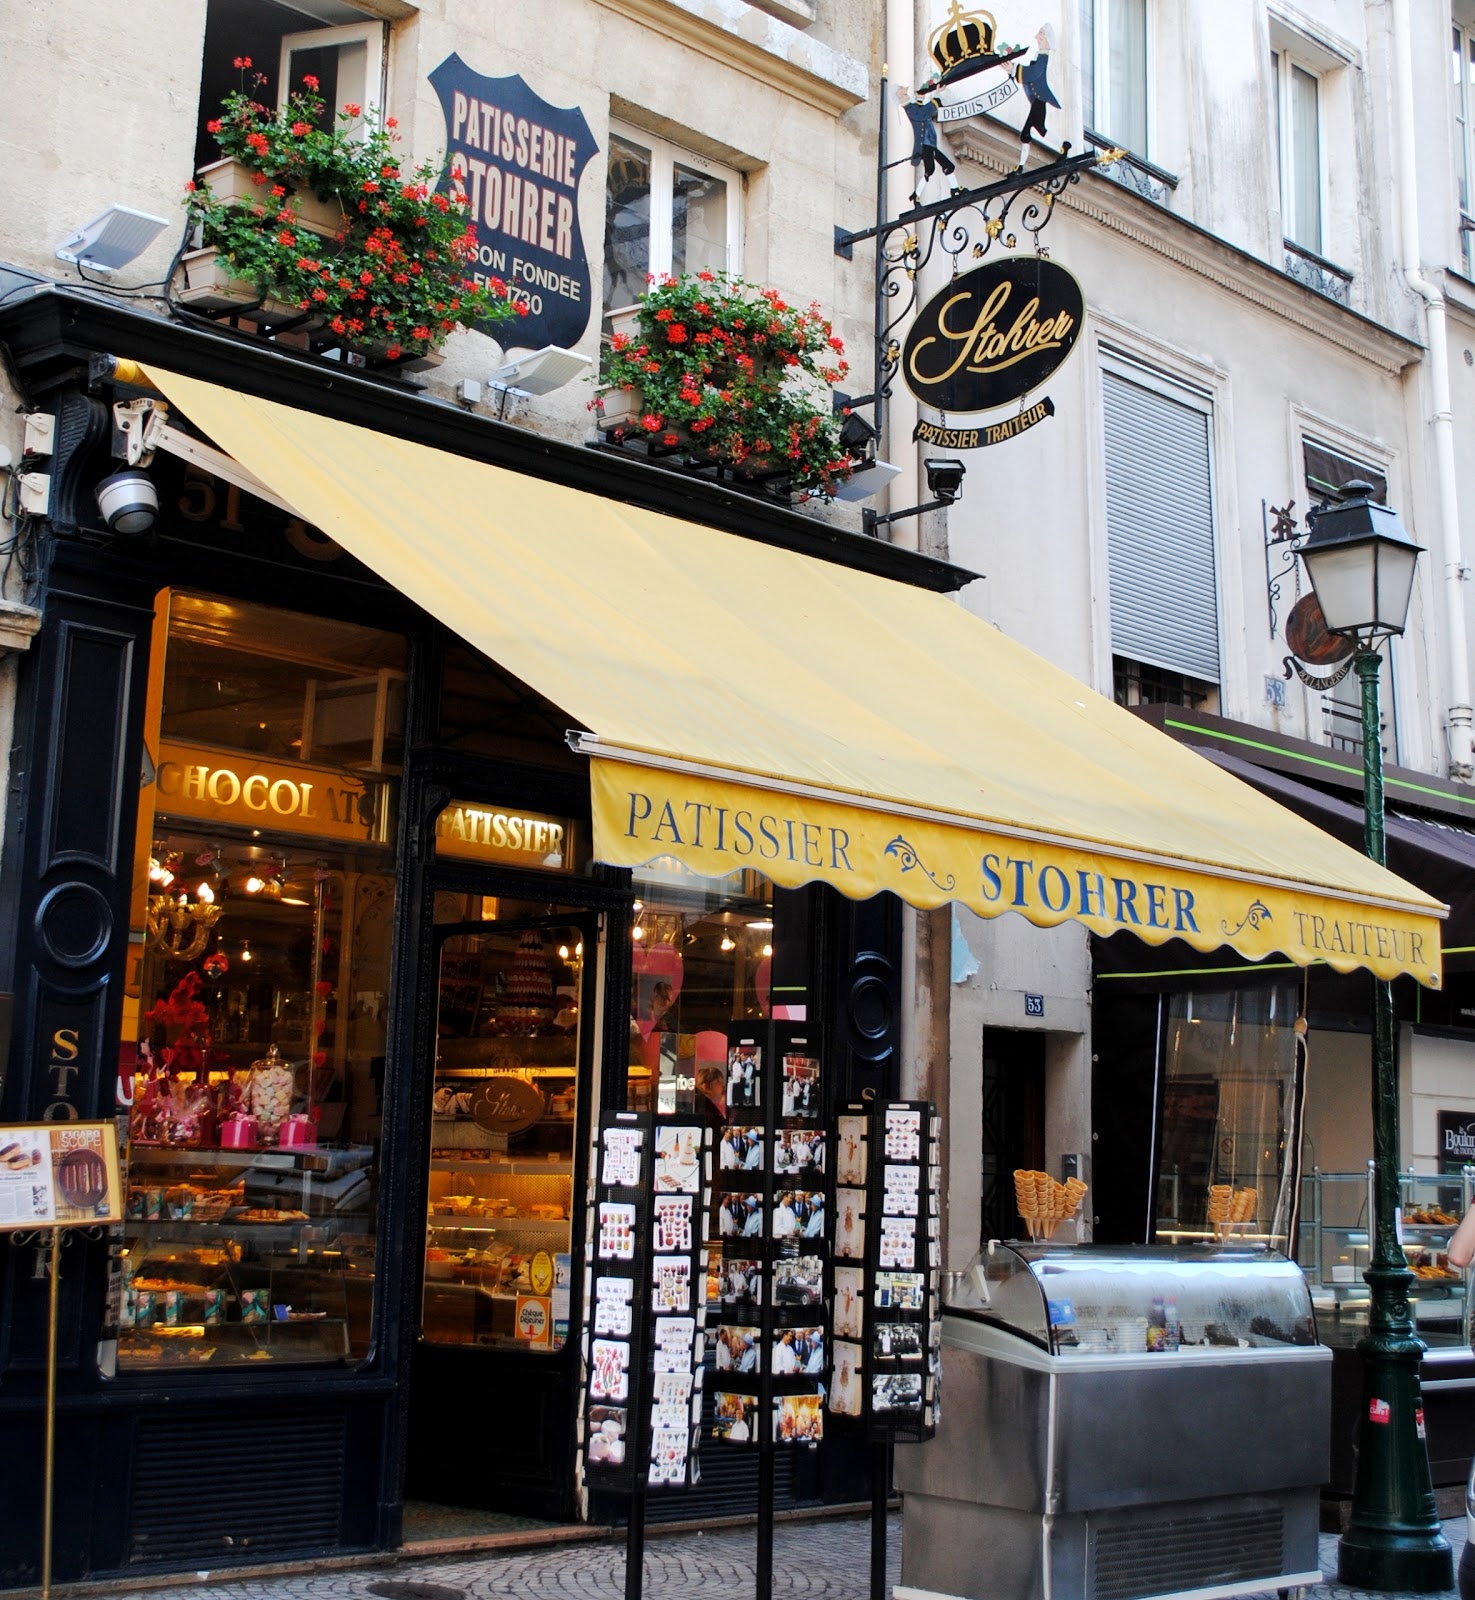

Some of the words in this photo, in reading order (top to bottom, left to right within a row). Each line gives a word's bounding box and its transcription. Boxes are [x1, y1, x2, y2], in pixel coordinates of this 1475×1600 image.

[943, 98, 983, 119] DEPUIS
[988, 84, 1011, 106] 1730
[453, 91, 577, 188] PATISSERIE
[910, 281, 1074, 385] Stohrer
[917, 423, 978, 448] PATISSIER
[985, 402, 1047, 444] TRAITEUR
[1267, 679, 1285, 704] 53
[624, 792, 854, 871] PATISSIER
[981, 853, 1200, 933] STOHRER
[1293, 911, 1427, 965] TRAITEUR
[1028, 997, 1041, 1012] 53
[61, 1136, 101, 1147] SCOPE
